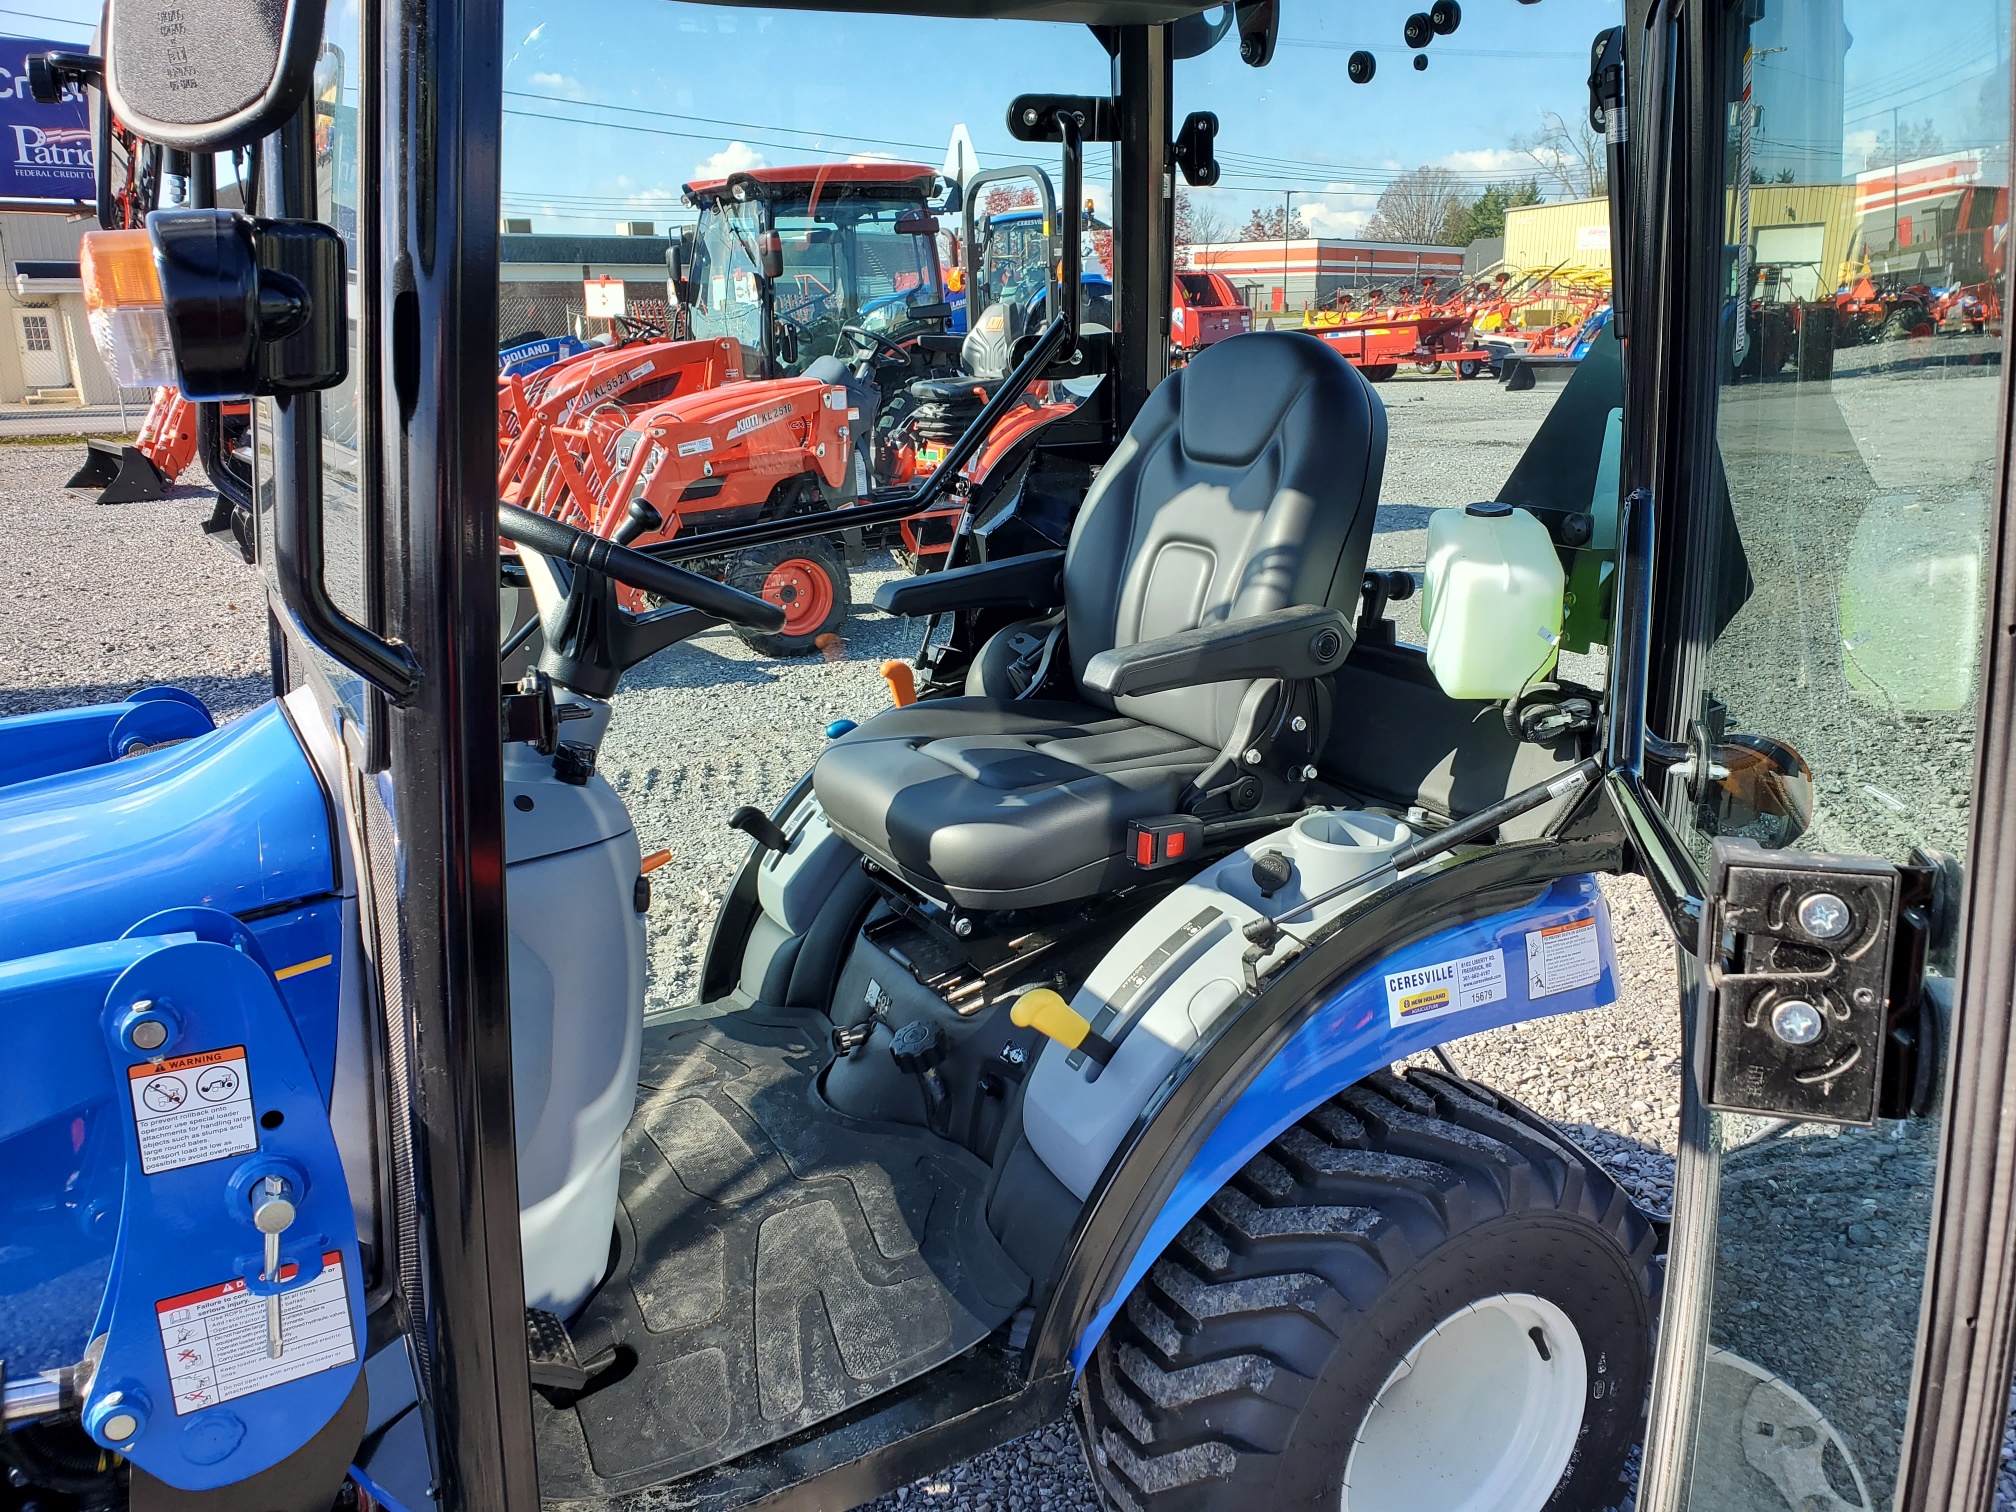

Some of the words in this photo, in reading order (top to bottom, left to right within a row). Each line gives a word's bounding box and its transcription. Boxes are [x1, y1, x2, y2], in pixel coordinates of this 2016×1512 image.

[8, 125, 94, 166] Patrio
[15, 169, 51, 177] FEDERAL
[53, 170, 85, 179] CREDIT
[502, 343, 550, 365] HOLLAND
[736, 414, 760, 433] KIOTI
[1390, 966, 1453, 992] CERESVILLE
[1472, 957, 1488, 966] LIBERTY
[1411, 998, 1423, 1006] NEW
[1424, 993, 1446, 1002] HOLLAND
[1471, 990, 1493, 1004] 15679
[1411, 1004, 1438, 1014] AGRICULTURE
[169, 1054, 222, 1069] WARNING
[141, 1124, 173, 1135] operator
[189, 1116, 215, 1125] special
[217, 1110, 239, 1119] loader
[150, 1116, 178, 1126] prevent
[180, 1110, 208, 1119] rollback
[142, 1129, 187, 1141] attachments
[200, 1120, 232, 1130] handling
[233, 1115, 251, 1123] large
[143, 1140, 170, 1149] objects
[201, 1128, 228, 1137] stumps
[144, 1148, 163, 1156] large
[164, 1142, 186, 1151] round
[145, 1152, 180, 1163] Transport
[146, 1160, 177, 1170] possible
[188, 1152, 208, 1160] avoid
[196, 1300, 222, 1310] Failure
[233, 1291, 253, 1301] comp
[198, 1306, 225, 1317] serious
[227, 1299, 250, 1309] injury.
[224, 1309, 243, 1318] ROPS
[226, 1309, 267, 1323] recommende
[213, 1323, 238, 1334] Operate
[239, 1317, 260, 1326] tractor
